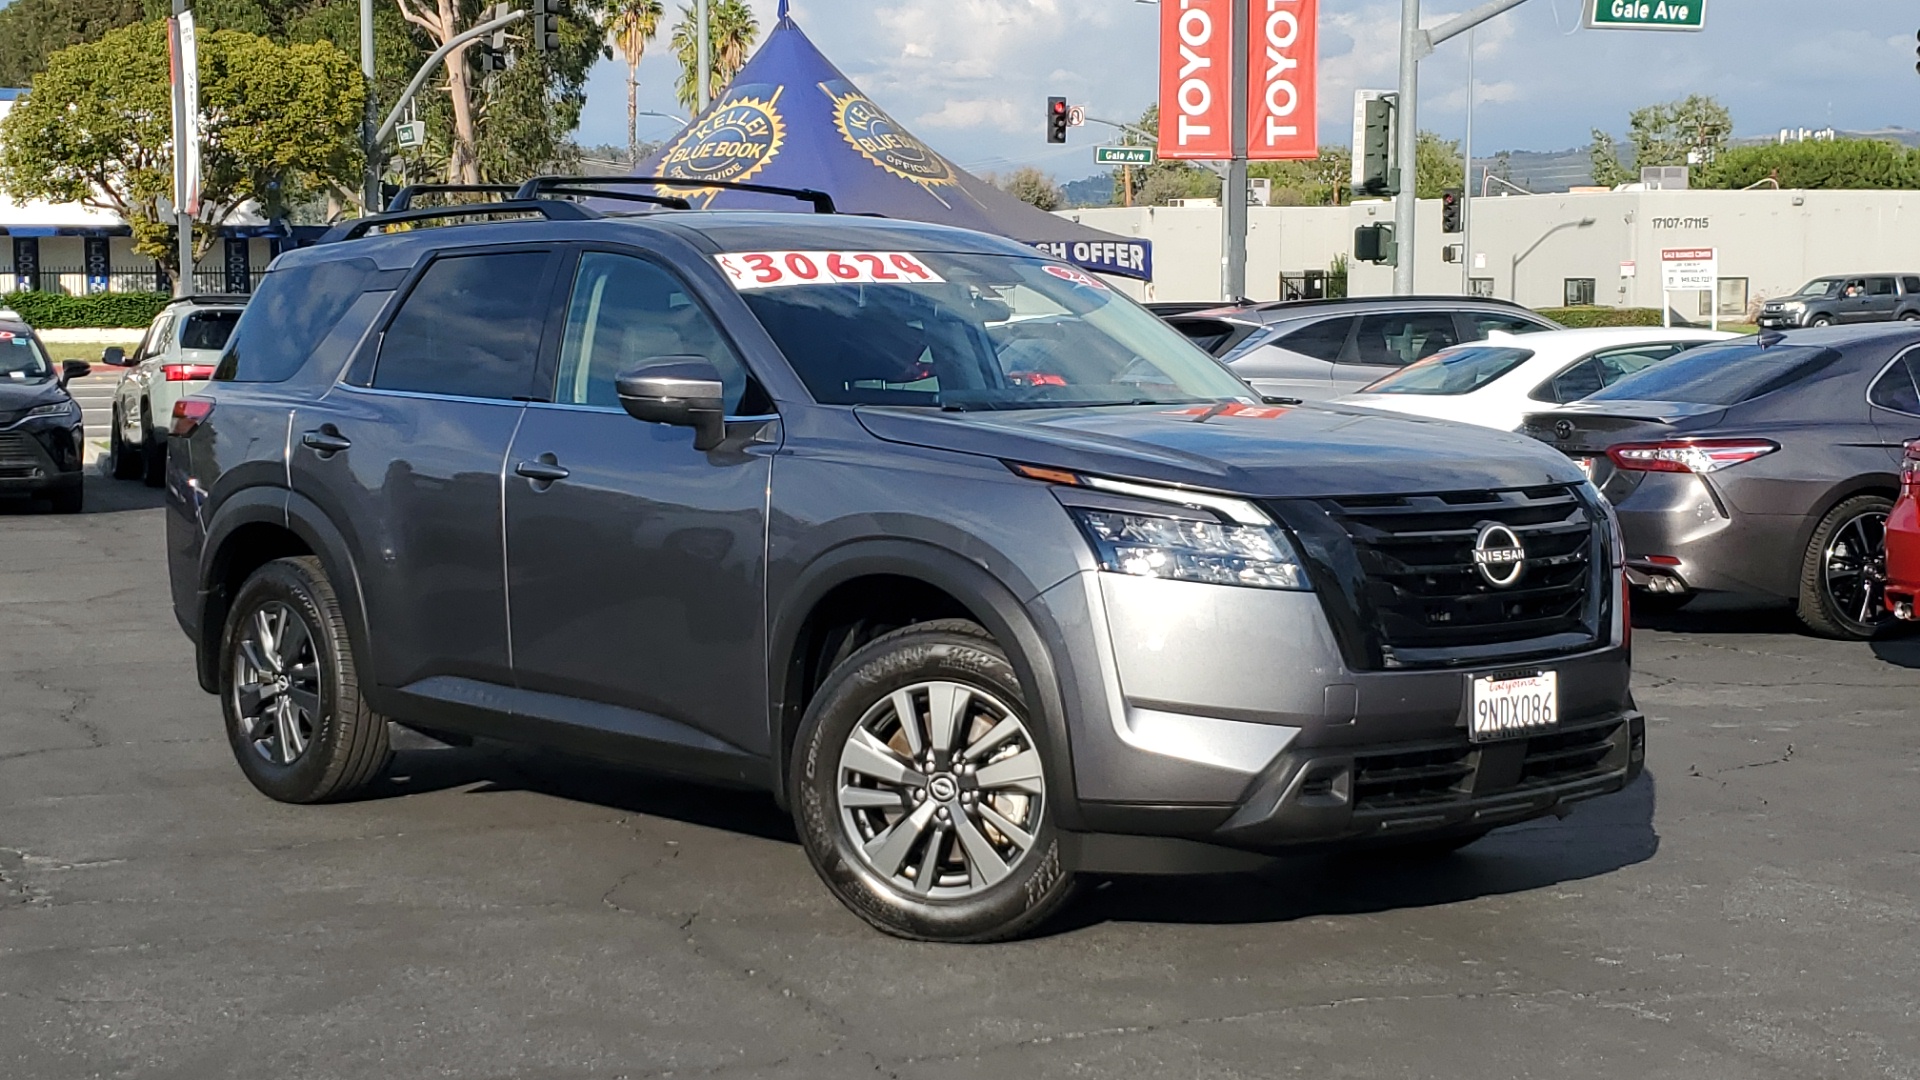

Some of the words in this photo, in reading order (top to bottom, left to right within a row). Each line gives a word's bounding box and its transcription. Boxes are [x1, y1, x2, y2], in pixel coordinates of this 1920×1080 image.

[1611, 0, 1650, 18] Gale
[1653, 1, 1689, 20] Ave
[696, 110, 769, 140] KELLEY
[670, 142, 717, 163] BLUE
[713, 141, 767, 159] BOOK
[1105, 151, 1125, 160] Gale
[1127, 151, 1144, 160] Ave
[704, 163, 743, 181] GUIDE
[1073, 242, 1144, 271] OFFER
[1474, 548, 1525, 564] NISSAN
[1478, 691, 1552, 733] 9NDX086
